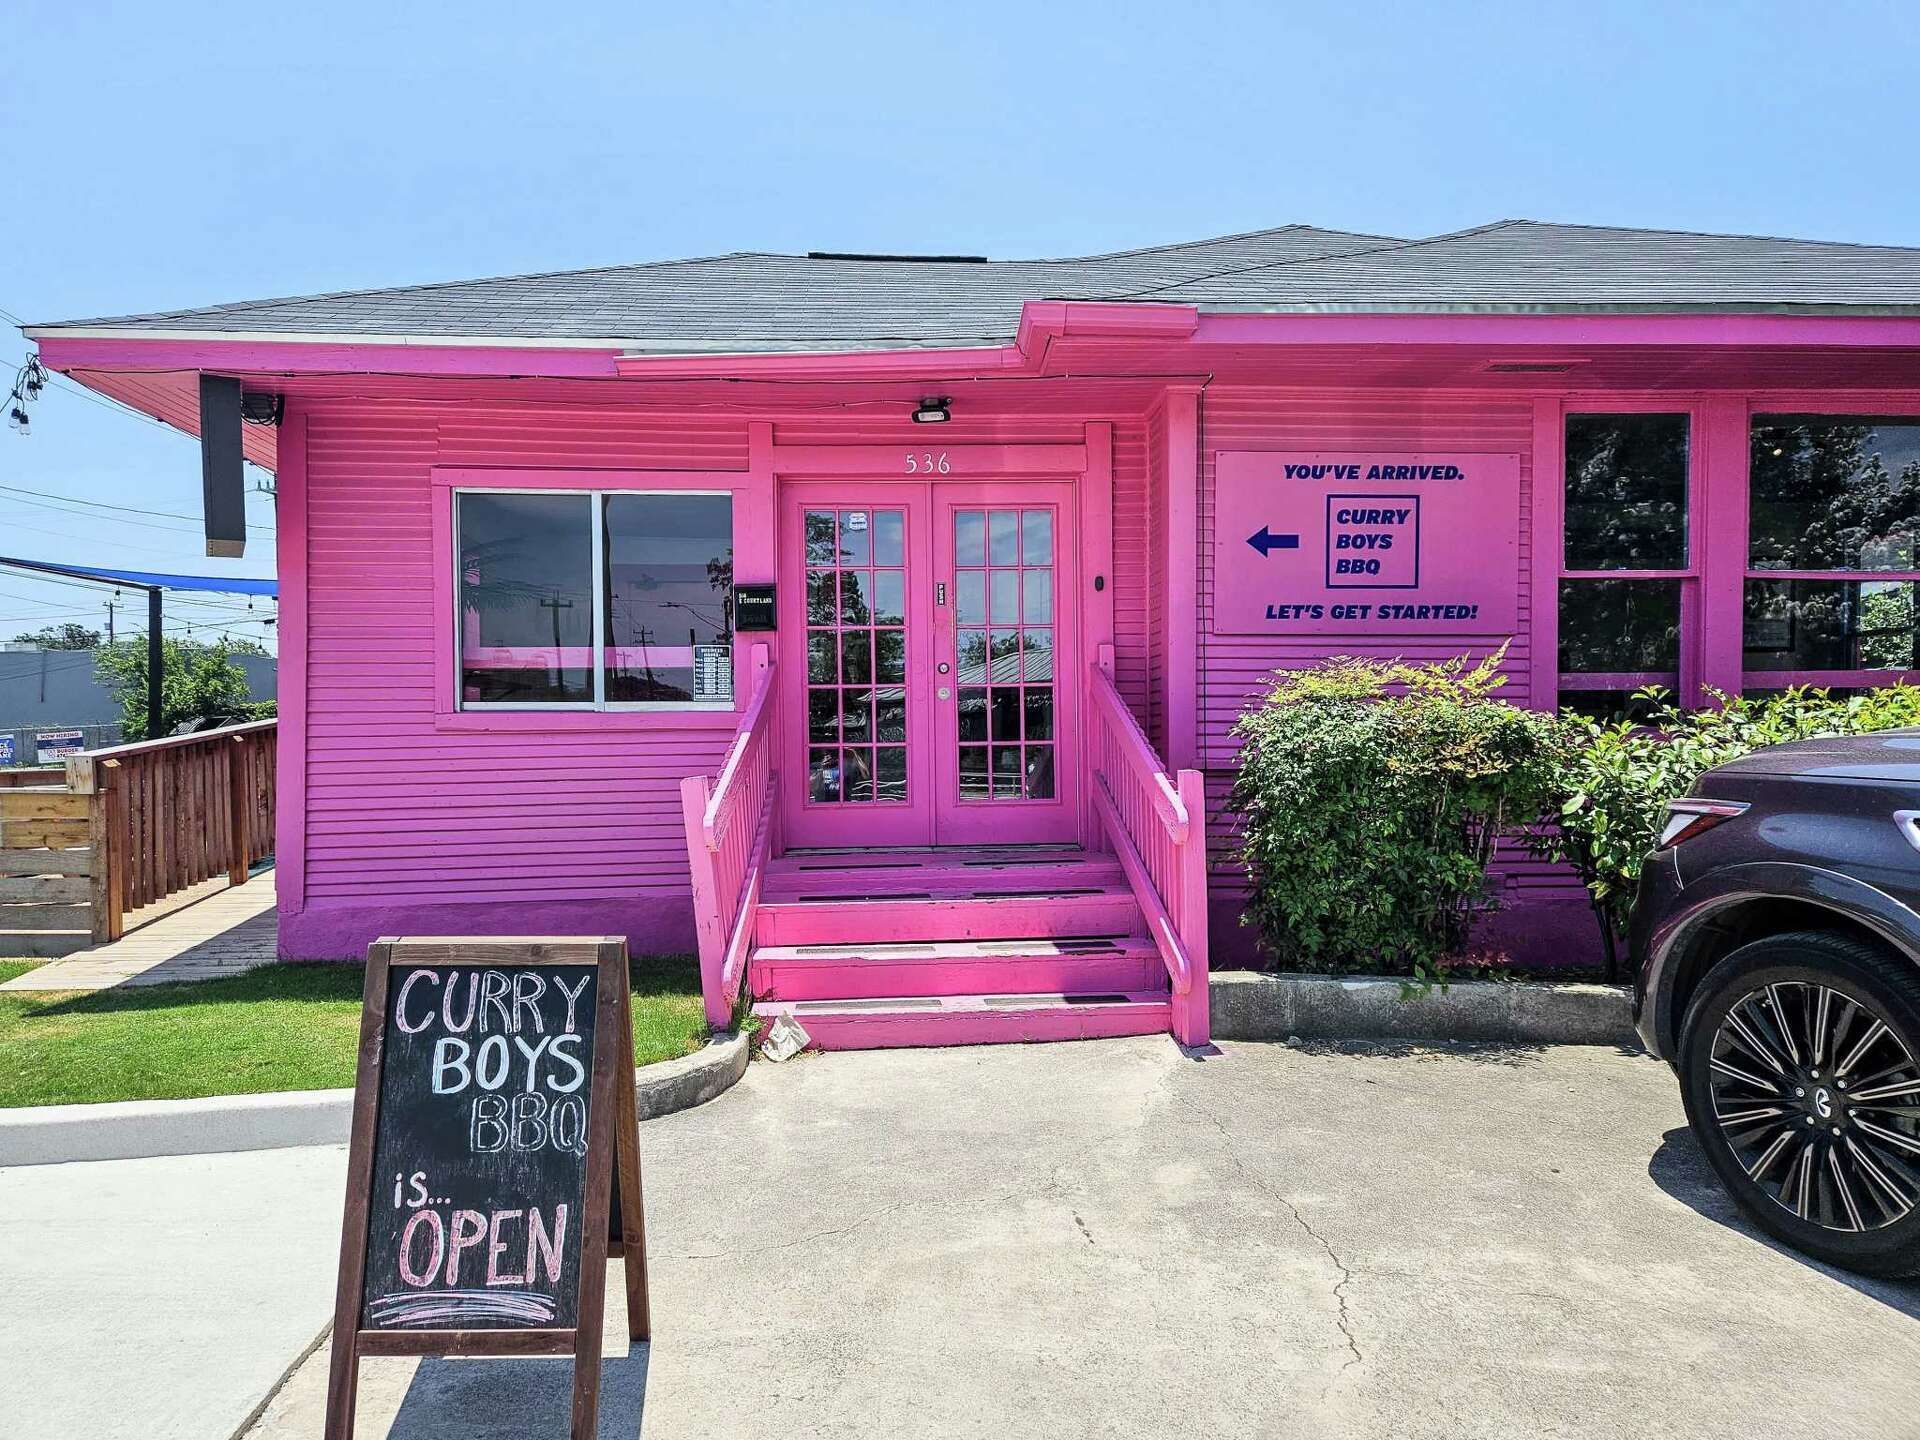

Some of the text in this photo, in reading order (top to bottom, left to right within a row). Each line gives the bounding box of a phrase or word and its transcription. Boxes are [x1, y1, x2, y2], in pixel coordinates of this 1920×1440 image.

[904, 452, 951, 474] 536
[1284, 465, 1465, 481] YOU'VE ARRIVED.
[1336, 509, 1411, 525] CURRY
[1336, 534, 1393, 550] BOYS
[1335, 558, 1381, 575] BBQ
[1265, 604, 1479, 620] LET'S GET STARTED!
[395, 969, 591, 1033] CURRY
[432, 1034, 585, 1094] BOYS
[470, 1092, 589, 1156] BBQ
[400, 1204, 568, 1287] OPEN
